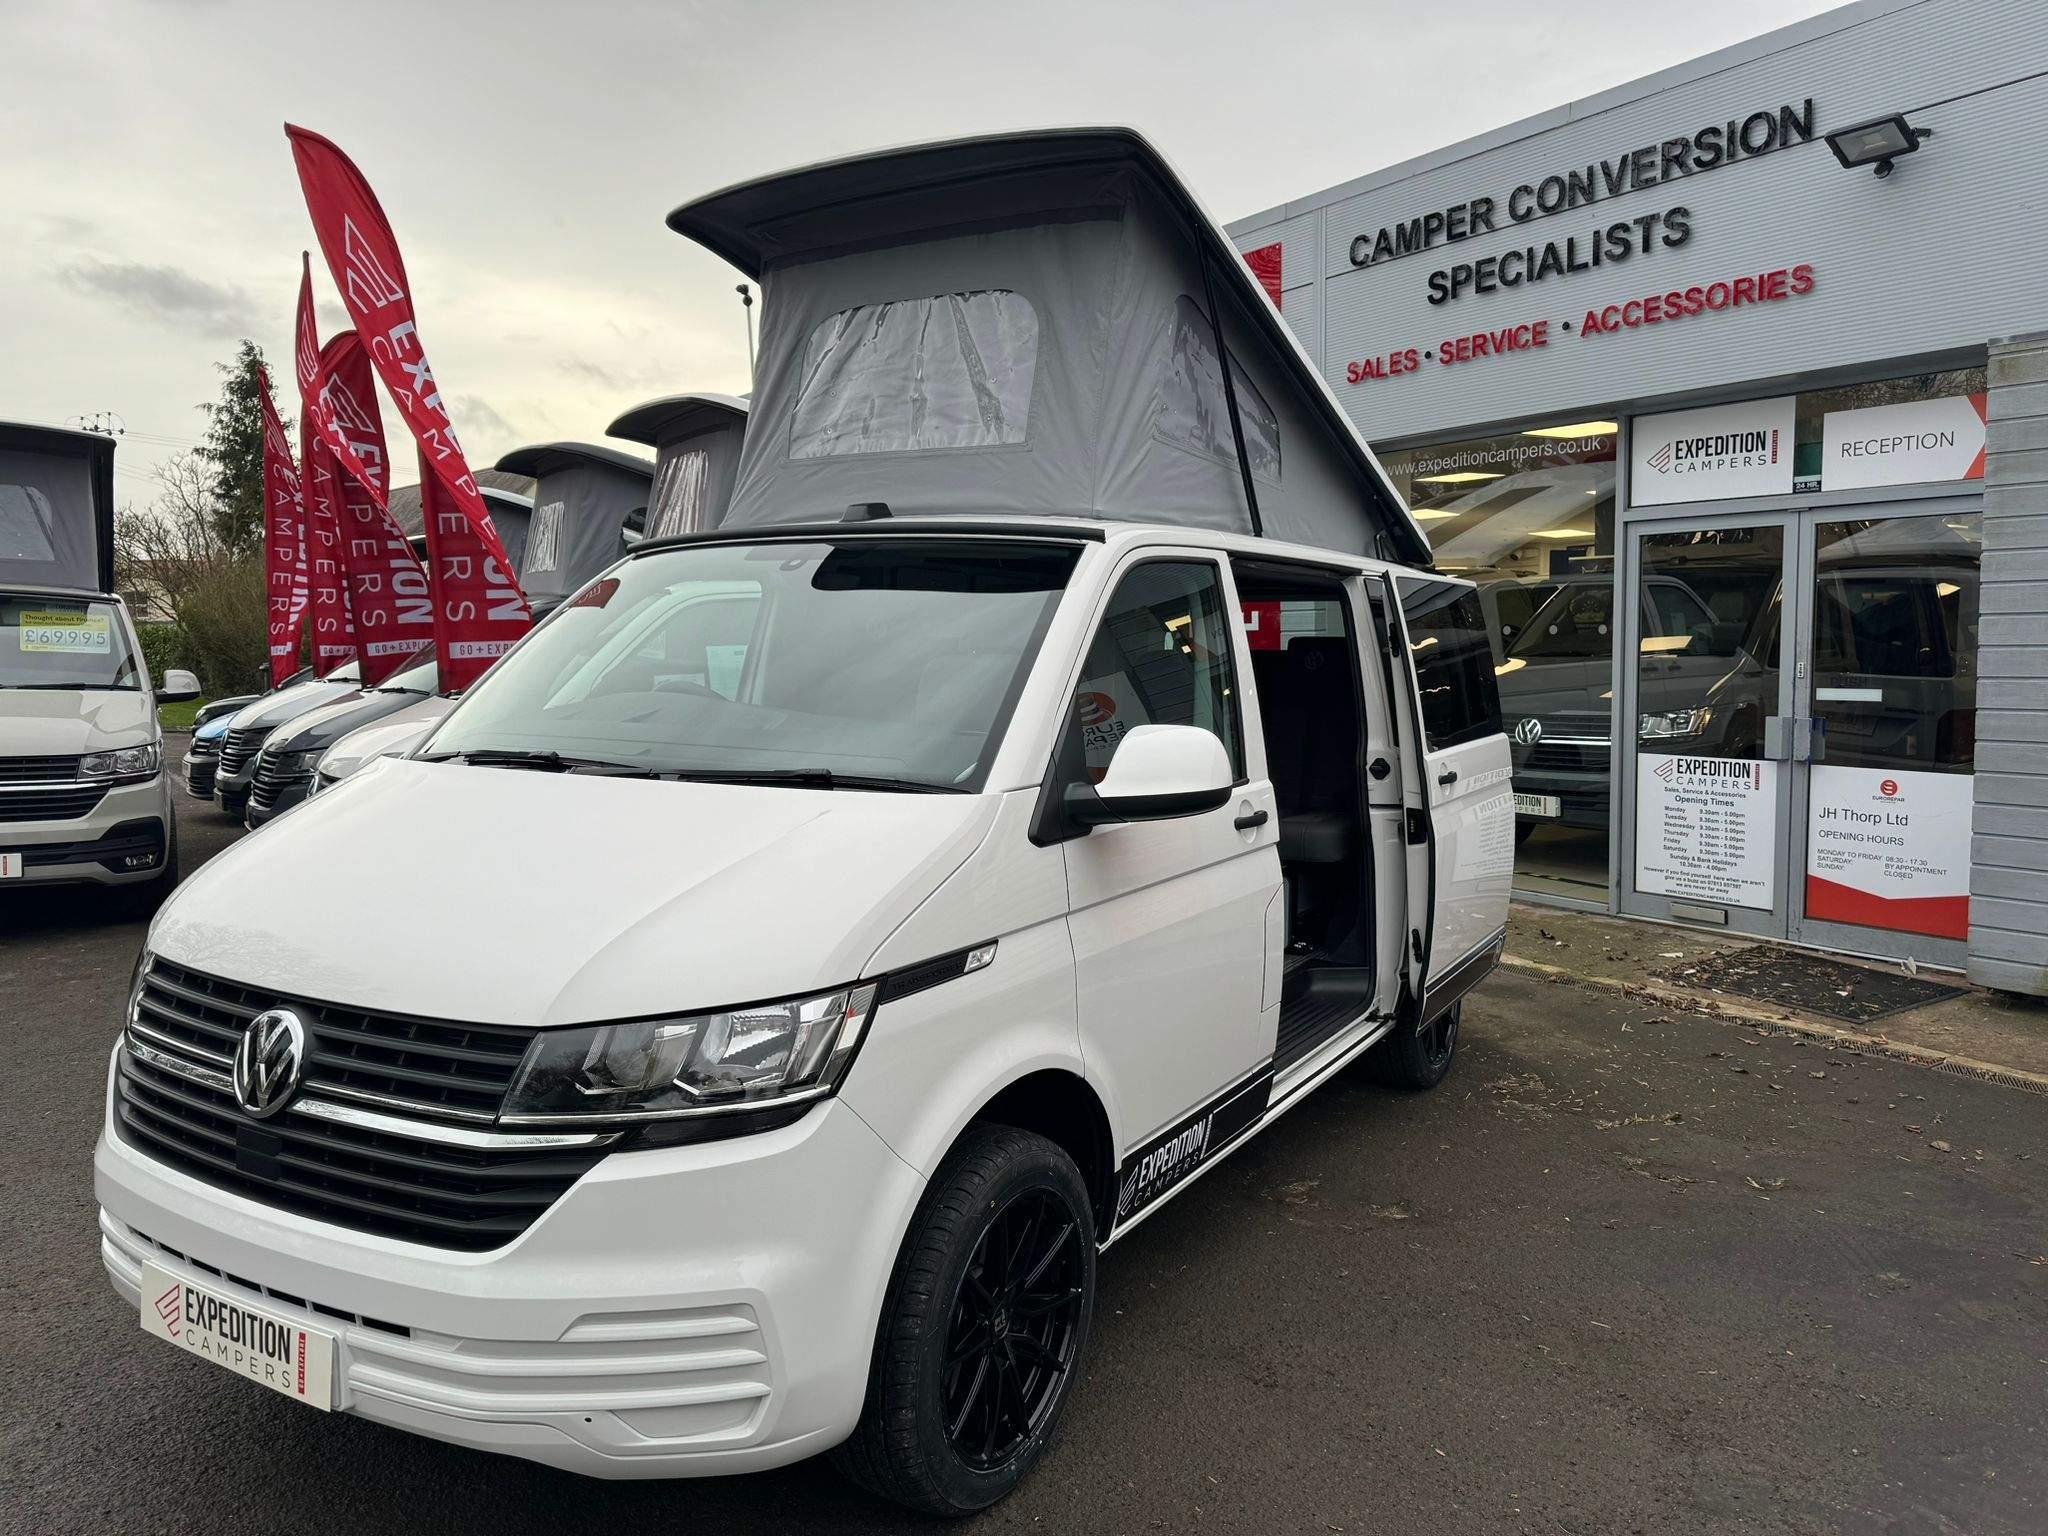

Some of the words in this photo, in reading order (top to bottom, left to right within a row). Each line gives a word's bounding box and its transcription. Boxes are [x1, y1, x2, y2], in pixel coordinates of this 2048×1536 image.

[1349, 197, 1495, 268] CAMPER
[1508, 98, 1813, 222] CONVERSION
[1427, 206, 1690, 305] SPECIALISTS
[1346, 348, 1418, 384] SALES
[1439, 320, 1548, 365] SERVICE
[1580, 264, 1815, 338] ACCESSORIES
[1675, 430, 1767, 460] EXPEDITION
[1841, 431, 1955, 458] RECEPTION
[1385, 434, 1601, 476] www.expeditioncampers.co.uk
[1674, 454, 1767, 474] CAMPERS
[270, 463, 293, 635] CAMPERS
[25, 614, 53, 622] Thought
[25, 629, 106, 645] £69995
[459, 645, 473, 655] GO
[1677, 759, 1751, 779] EXPEDITION
[1664, 786, 1681, 794] Sales,
[1710, 790, 1747, 799] Accessories
[1676, 776, 1751, 790] CAMPERS
[1674, 795, 1708, 806] Opening
[1710, 797, 1735, 807] Times
[1664, 822, 1695, 830] Wednesday
[1819, 807, 1837, 820] JH
[1841, 808, 1882, 826] Thorp
[1886, 812, 1909, 827] Ltd
[1664, 829, 1689, 837] Thursday
[1818, 829, 1864, 842] OPENING
[1866, 835, 1905, 846] HOURS
[1663, 845, 1687, 853] Saturday
[1817, 848, 1846, 857] MONDAY
[1847, 851, 1857, 859] TO
[1669, 853, 1690, 861] Sunday
[1712, 858, 1738, 867] Holidays
[1817, 855, 1853, 865] SATURDAY:
[1895, 864, 1948, 876] APPOINTMENT
[1816, 862, 1846, 871] SUNDAY:
[1884, 870, 1913, 879] CLOSED
[1138, 1118, 1207, 1190] EXPEDITION
[1134, 1151, 1200, 1207] CAMPERS
[185, 1286, 291, 1365] EXPEDITION
[186, 1328, 291, 1389] CAMPERS
